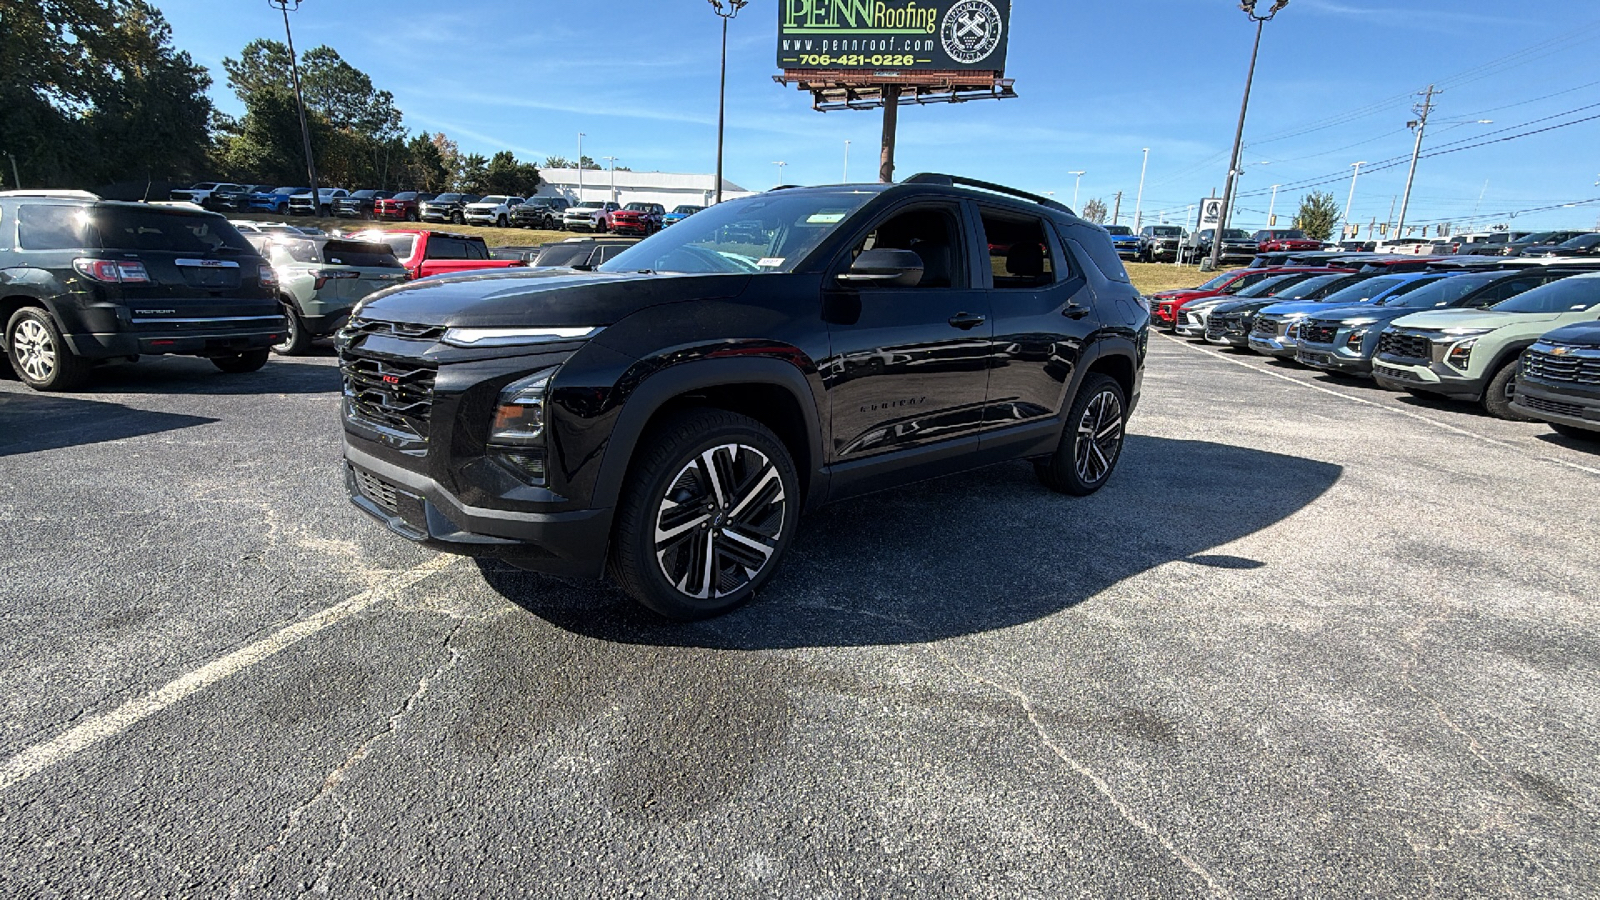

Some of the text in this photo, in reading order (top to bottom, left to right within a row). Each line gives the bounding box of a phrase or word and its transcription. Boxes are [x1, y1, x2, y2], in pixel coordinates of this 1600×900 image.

[782, 0, 937, 34] PENN Roofing
[782, 36, 934, 54] www.pennroof.com
[799, 54, 914, 66] 706-421-0226
[383, 375, 399, 384] RS
